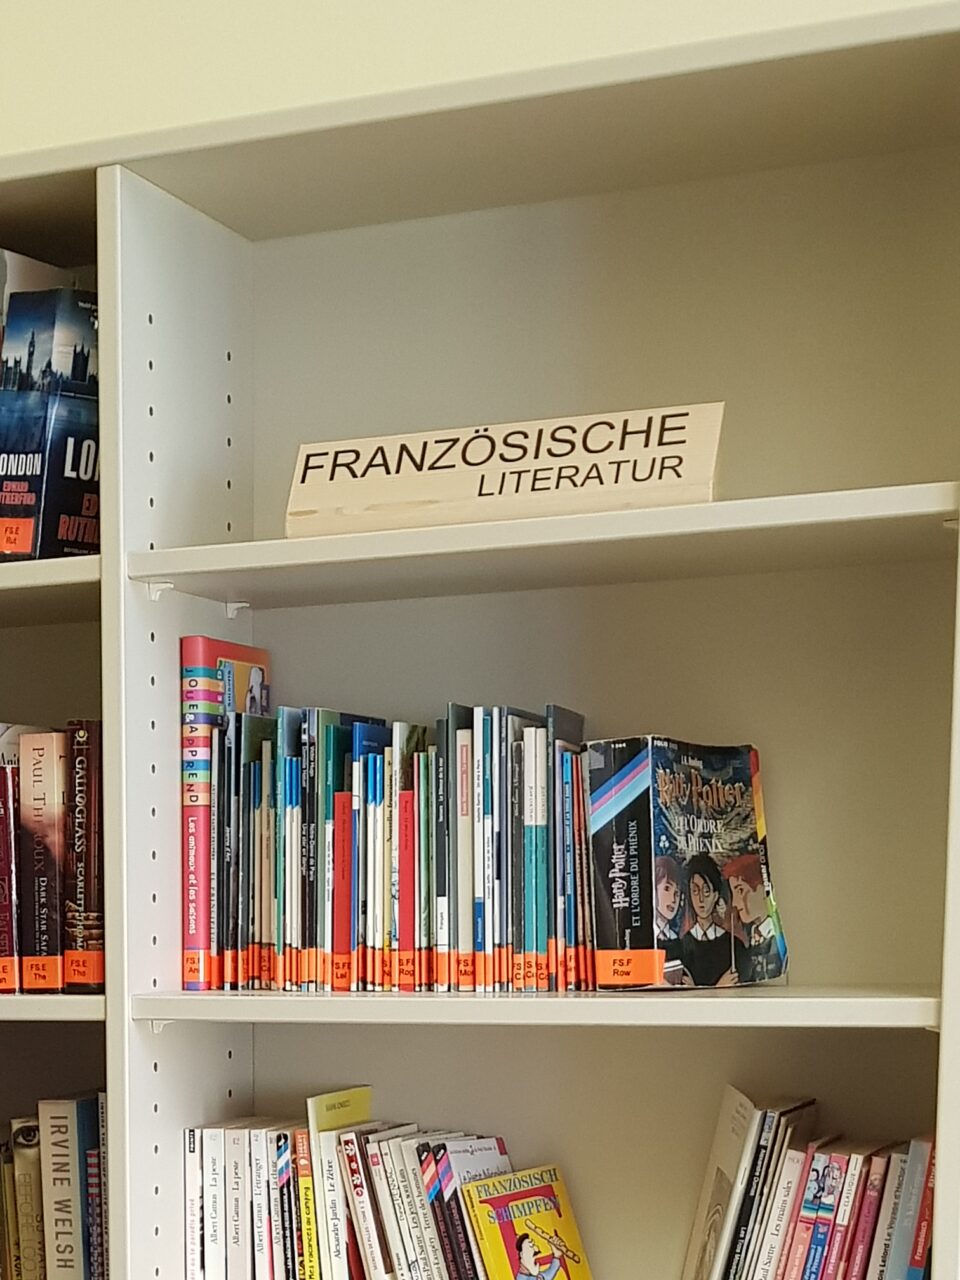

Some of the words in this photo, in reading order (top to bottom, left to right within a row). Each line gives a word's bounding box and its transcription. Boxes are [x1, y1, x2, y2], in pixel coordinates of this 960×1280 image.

[299, 412, 690, 485] FRANZÖSISCHE
[477, 455, 684, 497] LITERATUR
[184, 666, 199, 711] JOUE
[185, 713, 199, 723] &
[32, 747, 45, 787] PAUL
[184, 724, 199, 804] APPREND
[75, 756, 87, 853] GALLOGLASS
[188, 815, 198, 834] Les
[628, 820, 637, 856] PHÉNIX
[188, 835, 198, 871] animaux
[609, 843, 627, 878] Potter
[630, 858, 638, 872] DU
[76, 861, 84, 908] SCARLETT
[188, 873, 198, 885] et
[188, 886, 198, 901] les
[611, 878, 629, 909] Harry
[630, 873, 640, 913] L'ORDRE
[188, 902, 198, 935] saisons
[631, 914, 640, 927] ET
[612, 959, 632, 967] FS.F
[613, 969, 631, 977] Row
[49, 1116, 71, 1188] IRVINE
[232, 1161, 241, 1180] peste
[254, 1157, 264, 1197] L'étranger
[326, 1159, 335, 1181] Zèbre
[232, 1180, 240, 1191] La
[328, 1181, 335, 1192] Le
[476, 1169, 560, 1198] FRANZÖSISCH
[783, 1180, 793, 1197] sales
[844, 1173, 856, 1207] CLASSIQUE
[232, 1197, 240, 1222] Camus
[255, 1203, 263, 1229] Camus
[331, 1199, 340, 1221] Jardin
[487, 1197, 560, 1223] SCHIMPFEN
[776, 1200, 789, 1221] mains
[54, 1199, 74, 1269] WELSH
[232, 1223, 240, 1246] Albert
[256, 1230, 264, 1254] Albert
[332, 1222, 341, 1259] Alexandre
[771, 1223, 782, 1237] Les
[764, 1244, 776, 1267] Sartre
[853, 1245, 863, 1276] vacances
